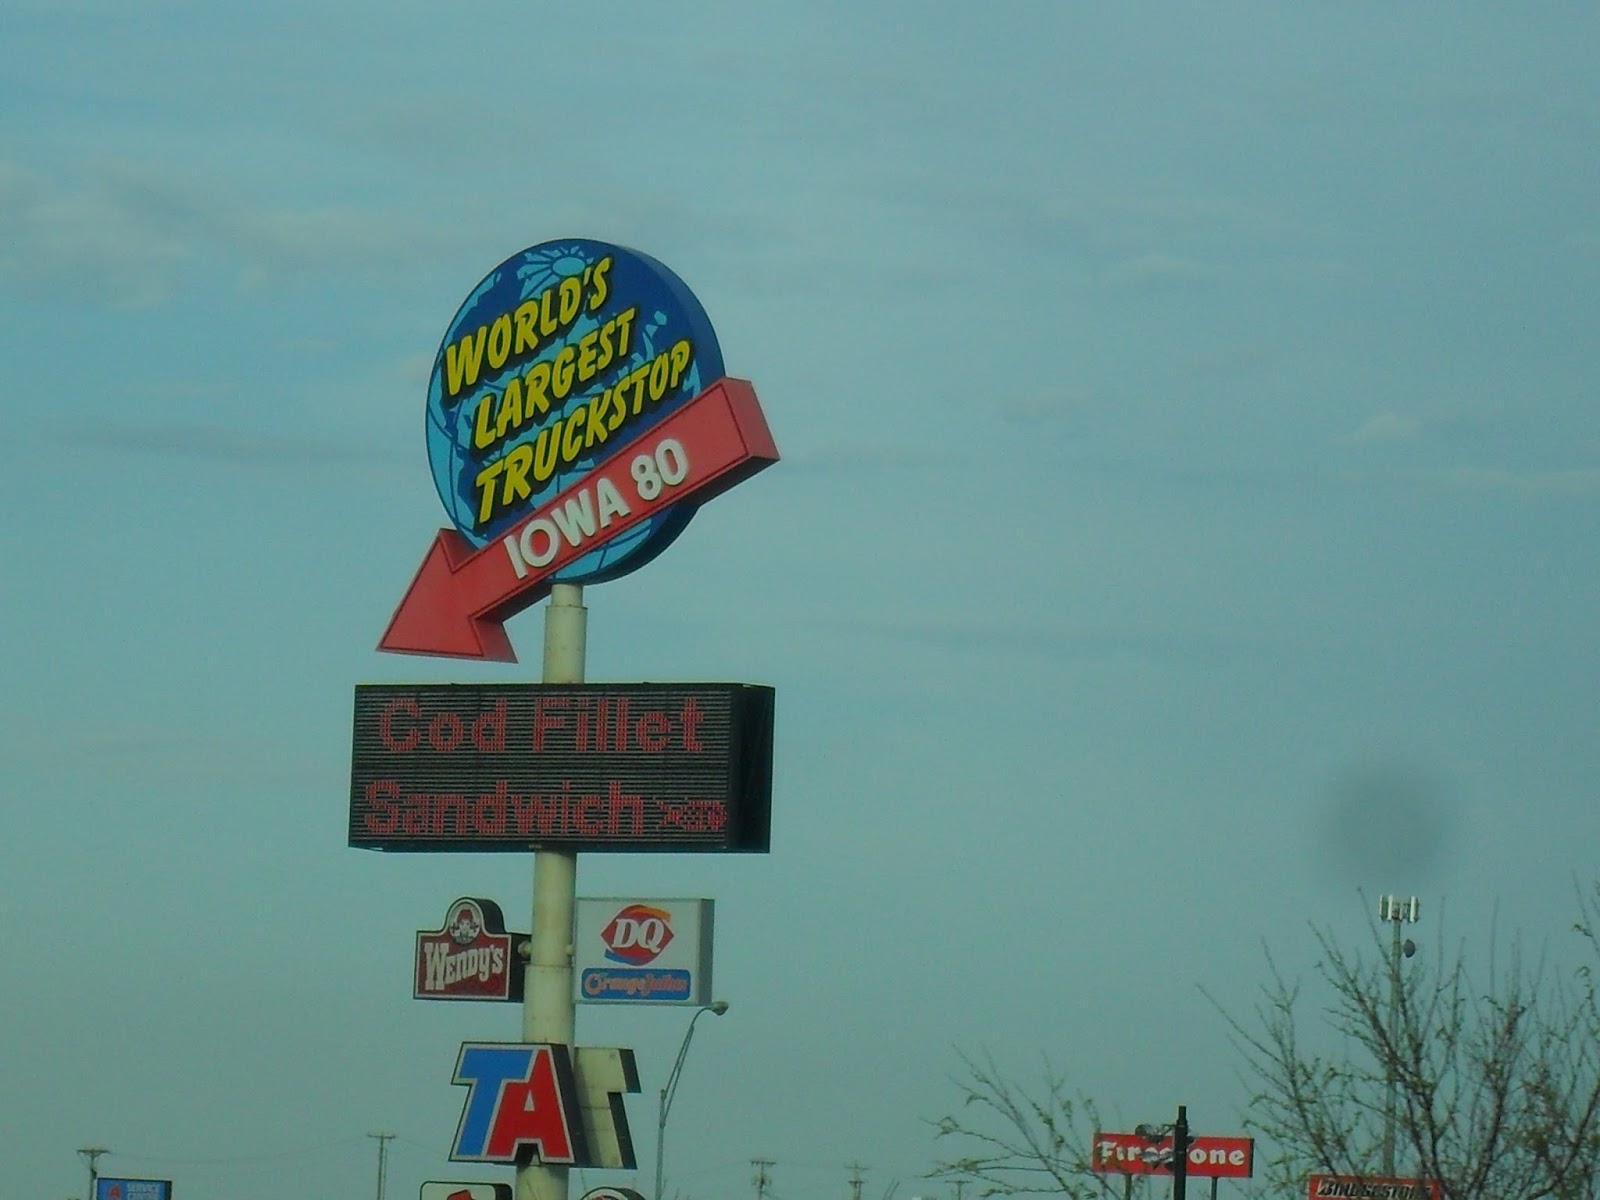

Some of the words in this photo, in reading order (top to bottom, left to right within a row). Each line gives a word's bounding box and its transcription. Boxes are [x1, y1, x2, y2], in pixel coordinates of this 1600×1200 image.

[445, 257, 612, 397] WORLD'S
[474, 308, 636, 450] LARGEST
[475, 340, 691, 524] TRUCKSTOP
[503, 478, 631, 579] IOWA
[630, 438, 689, 501] 80
[379, 696, 508, 752] Cod
[532, 696, 704, 752] Fillet
[364, 779, 644, 835] Sandwich
[424, 942, 504, 991] Wendy's
[611, 917, 665, 953] DQ
[449, 1042, 575, 1164] TA
[1097, 1141, 1246, 1166] Firesone
